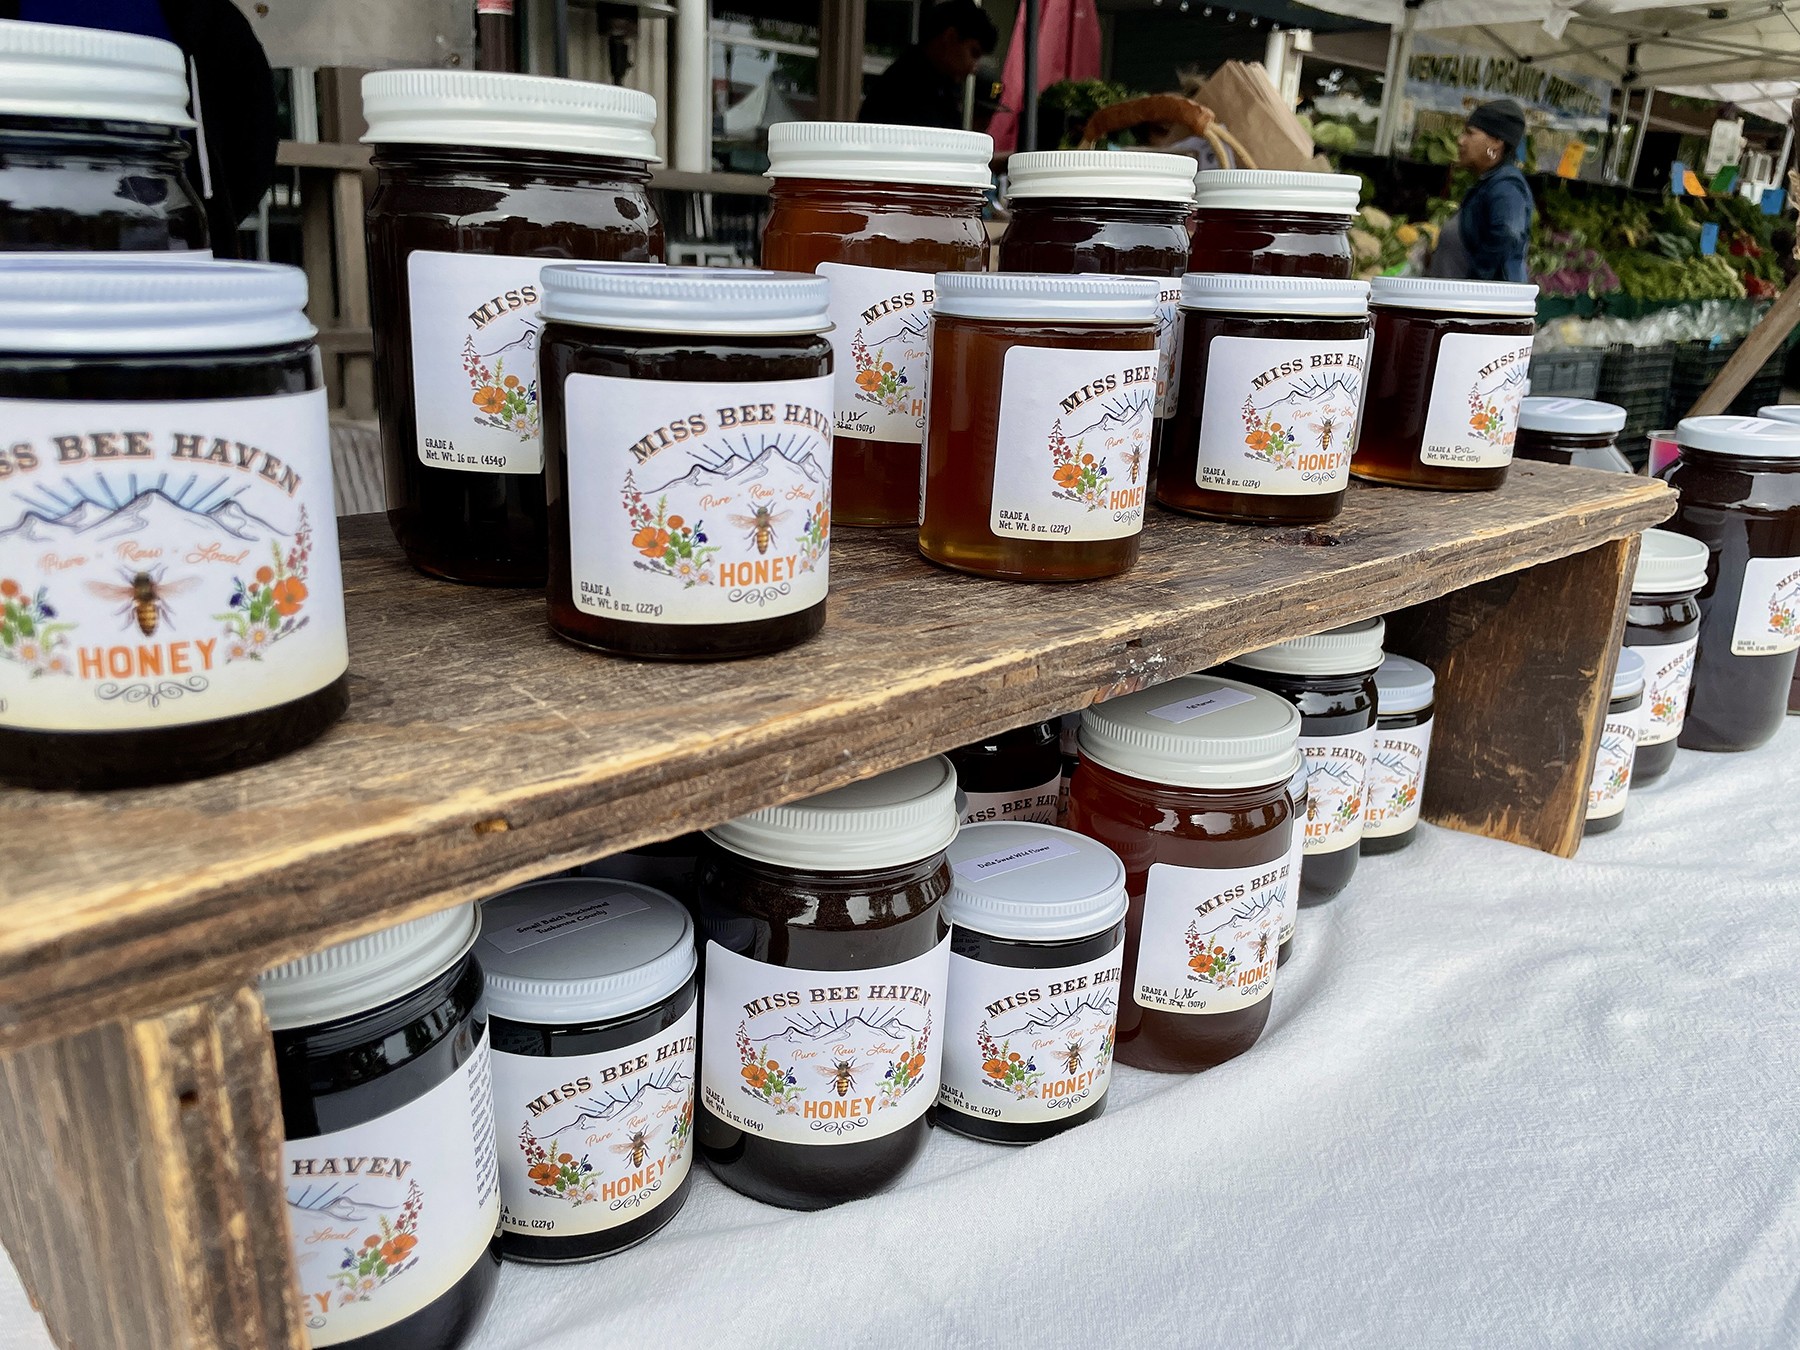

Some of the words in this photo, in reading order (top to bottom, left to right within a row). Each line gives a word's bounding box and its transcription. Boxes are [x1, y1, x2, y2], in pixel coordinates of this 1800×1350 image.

[468, 285, 539, 331] MISS
[861, 291, 915, 327] MISS
[904, 349, 926, 361] Pure
[1478, 352, 1515, 380] MISS
[1251, 357, 1304, 391] MISS
[1310, 352, 1344, 369] BEE
[1059, 373, 1117, 416] MISS
[1123, 366, 1151, 386] BEE
[1292, 410, 1312, 421] Pure
[425, 438, 447, 450] GRADE
[448, 441, 455, 450] A
[628, 412, 708, 465] MISS
[716, 403, 776, 428] BEE
[1105, 436, 1124, 450] Pure
[0, 442, 38, 479] SS
[53, 431, 154, 465] BEE
[171, 432, 301, 499] HAVEN
[426, 449, 440, 460] Net.
[441, 451, 455, 462] Wt.
[457, 453, 465, 463] 16
[467, 456, 479, 464] oz.
[481, 455, 507, 468] (454g)
[1297, 452, 1342, 471] HONEY
[1202, 475, 1213, 484] Net.
[1215, 476, 1225, 485] Wt.
[1242, 479, 1261, 489] (227g)
[1203, 466, 1220, 476] GRADE
[1221, 469, 1226, 477] A
[699, 495, 733, 512] Pure
[749, 483, 776, 499] Raw
[785, 483, 817, 502] Local
[1000, 510, 1023, 521] GRADE
[1024, 512, 1030, 521] A
[999, 520, 1013, 530] Net.
[1016, 521, 1029, 532] Wt.
[1031, 523, 1036, 532] 8
[1037, 525, 1047, 533] oz.
[1050, 524, 1072, 535] (227g)
[39, 552, 88, 572] Pure
[116, 540, 164, 562] Raw
[184, 541, 251, 566] Local
[719, 554, 798, 588] HONEY
[1776, 568, 1800, 591] MIS
[581, 581, 603, 595] GRADE
[605, 586, 612, 596] A
[581, 593, 596, 606] Net.
[597, 597, 612, 610] Wt.
[614, 600, 619, 611] 8
[621, 603, 633, 612] oz.
[636, 602, 663, 617] (227g)
[77, 637, 218, 680] HONEY
[1656, 653, 1685, 680] MISS
[1330, 747, 1367, 767] HAVEN
[1383, 739, 1423, 760] HAVEN
[967, 807, 996, 825] ISS
[1001, 797, 1032, 814] BEE
[1305, 823, 1331, 837] NEY
[1194, 884, 1245, 918] MISS
[1250, 869, 1279, 892] BEE
[516, 921, 542, 933] Small
[541, 915, 566, 925] Batch
[577, 909, 607, 921] County
[985, 987, 1041, 1019] MISS
[1048, 976, 1088, 997] BEE
[1141, 993, 1153, 1002] Net.
[1155, 996, 1167, 1005] Wt.
[1142, 985, 1161, 996] GRADE
[1162, 989, 1168, 997] A
[743, 990, 801, 1020] MISS
[809, 985, 861, 1004] BEE
[867, 985, 931, 1009] HAVEN
[1032, 1038, 1055, 1050] Pure
[1066, 1027, 1083, 1040] Raw
[791, 1049, 817, 1061] Pure
[831, 1043, 857, 1055] Raw
[866, 1042, 901, 1056] Local
[525, 1076, 593, 1118] MISS
[600, 1053, 650, 1085] BEE
[941, 1083, 958, 1097] GRADE
[959, 1091, 964, 1099] A
[1042, 1068, 1094, 1099] HONEY
[721, 1097, 726, 1106] A
[804, 1095, 876, 1119] HONEY
[965, 1101, 969, 1109] 8
[981, 1106, 1001, 1117] (227g)
[585, 1132, 613, 1147] Pure
[626, 1115, 649, 1130] Raw
[656, 1097, 682, 1119] Local
[726, 1109, 732, 1119] 16
[743, 1117, 764, 1131] (454g)
[292, 1156, 412, 1181] HAVEN
[602, 1155, 666, 1201] HONEY
[512, 1217, 517, 1225] 8
[518, 1219, 529, 1227] oz.
[531, 1219, 555, 1231] (227g)
[304, 1227, 359, 1247] Local
